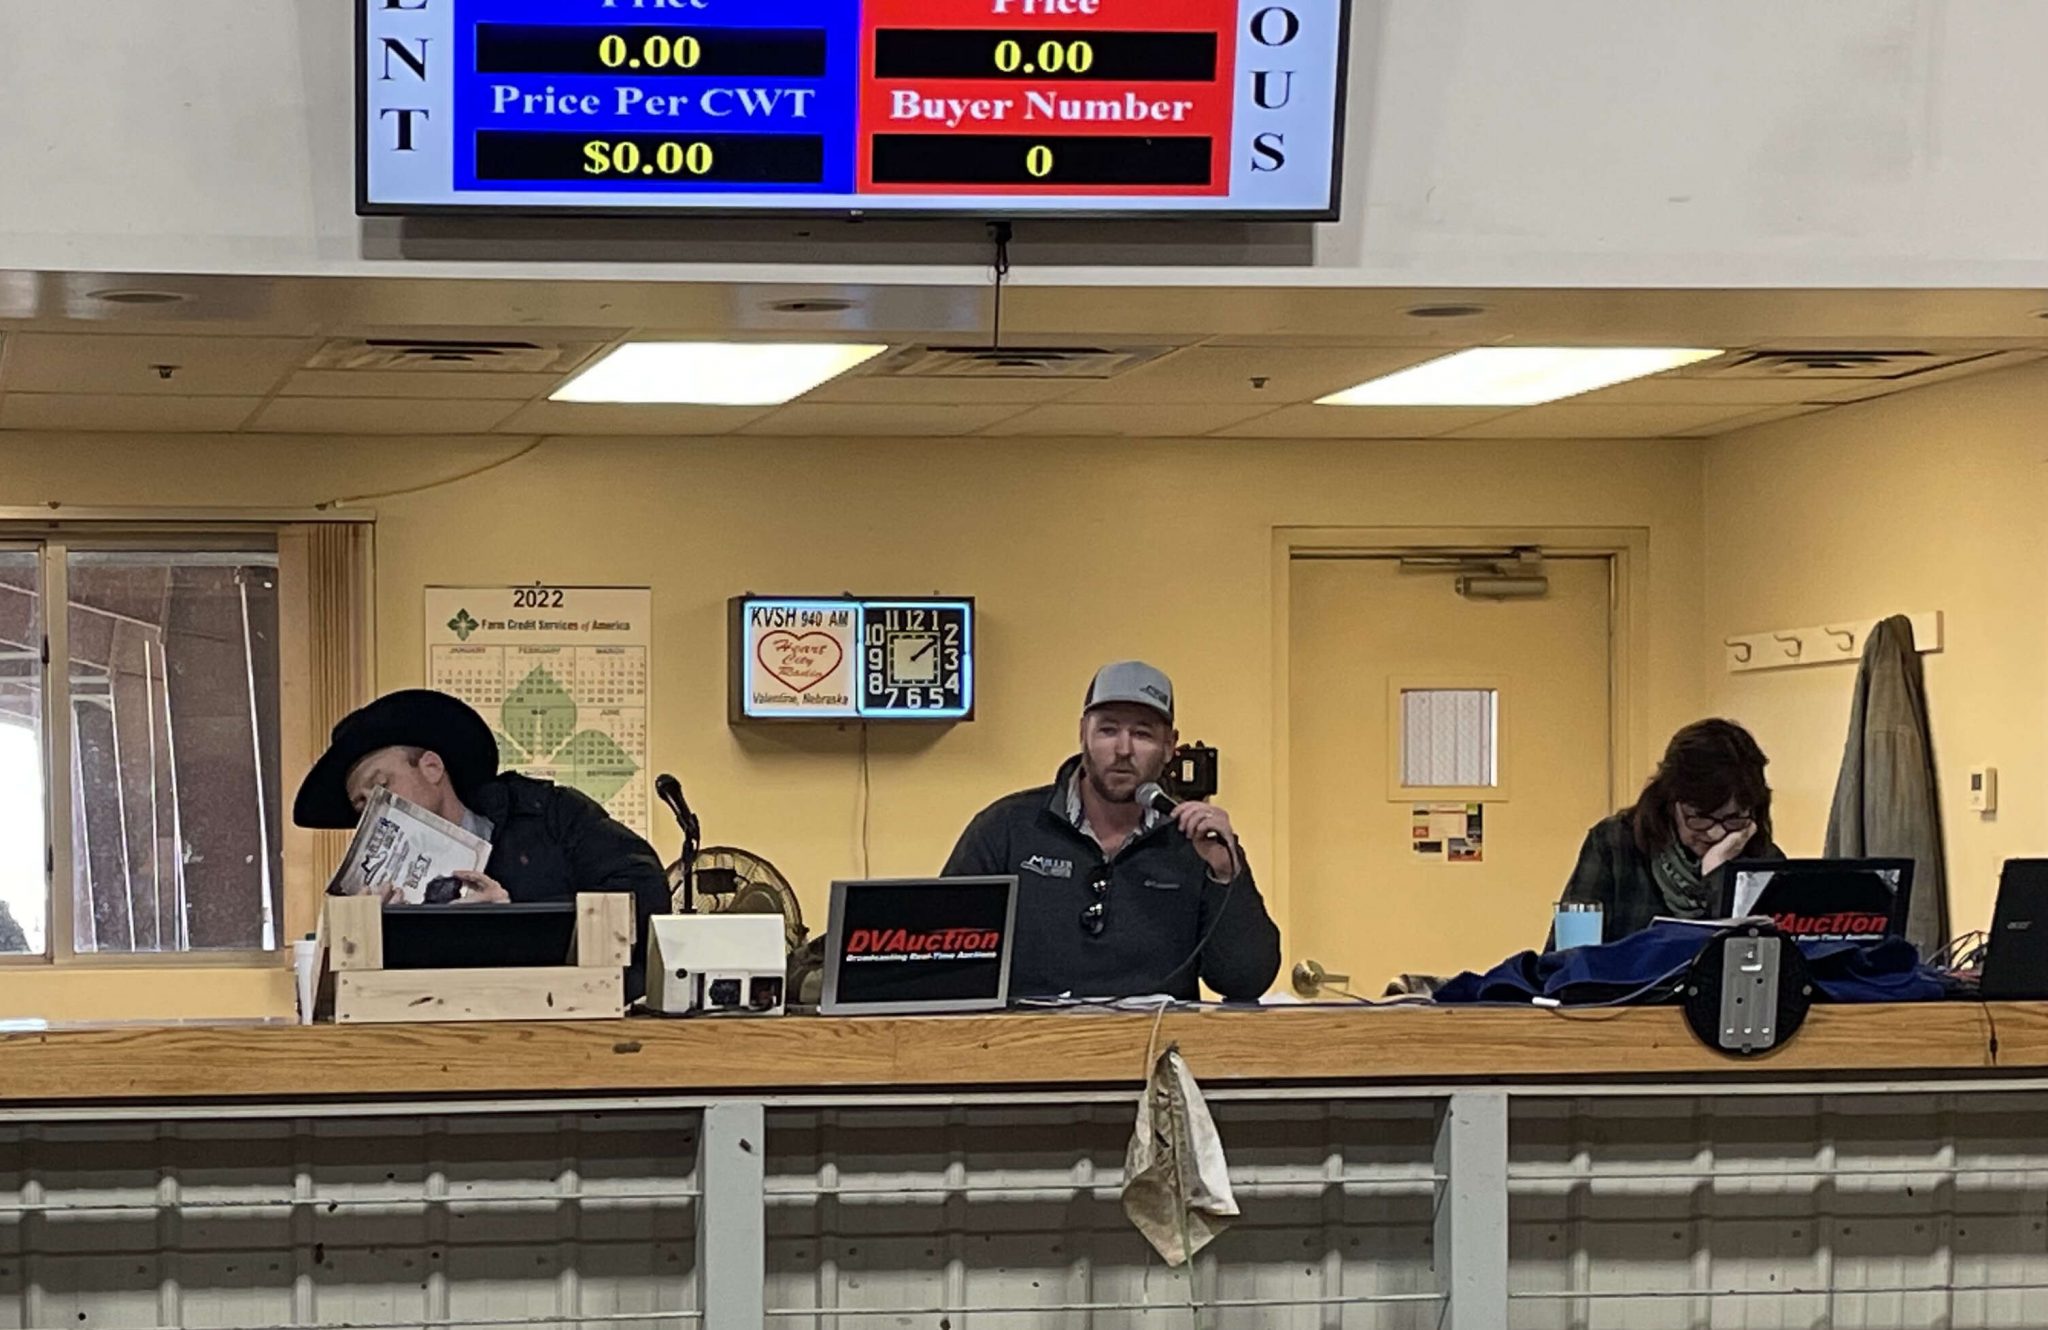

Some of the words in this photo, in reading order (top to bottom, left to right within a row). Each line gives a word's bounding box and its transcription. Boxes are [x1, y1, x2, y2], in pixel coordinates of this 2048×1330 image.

[599, 35, 701, 68] 0.00
[994, 40, 1094, 73] 0.00
[491, 84, 600, 115] Price
[614, 86, 688, 116] Per
[699, 88, 816, 118] CWT
[891, 90, 1013, 128] Buyer
[1024, 91, 1194, 121] Number
[583, 140, 714, 175] $0.00
[1026, 145, 1054, 177] 0
[513, 589, 564, 608] 2022
[481, 619, 506, 630] Farm
[507, 619, 537, 630] Credit
[538, 619, 579, 630] Services
[591, 619, 631, 630] America
[751, 606, 797, 628] KVSH
[801, 610, 823, 627] 940
[829, 610, 849, 627] AM
[885, 610, 900, 631] 11
[905, 610, 926, 631] 12
[932, 610, 939, 631] 1
[865, 623, 885, 646] 10
[944, 623, 960, 646] 2
[772, 638, 828, 657] Heart
[869, 648, 883, 671] 9
[944, 648, 959, 671] 3
[869, 672, 884, 695] 8
[944, 672, 960, 695] 4
[802, 692, 849, 705] Nebraska
[884, 688, 899, 709] 7
[906, 688, 922, 709] 6
[929, 688, 944, 709] 5
[1775, 912, 1889, 933] Auction
[847, 927, 1000, 952] DVAuction
